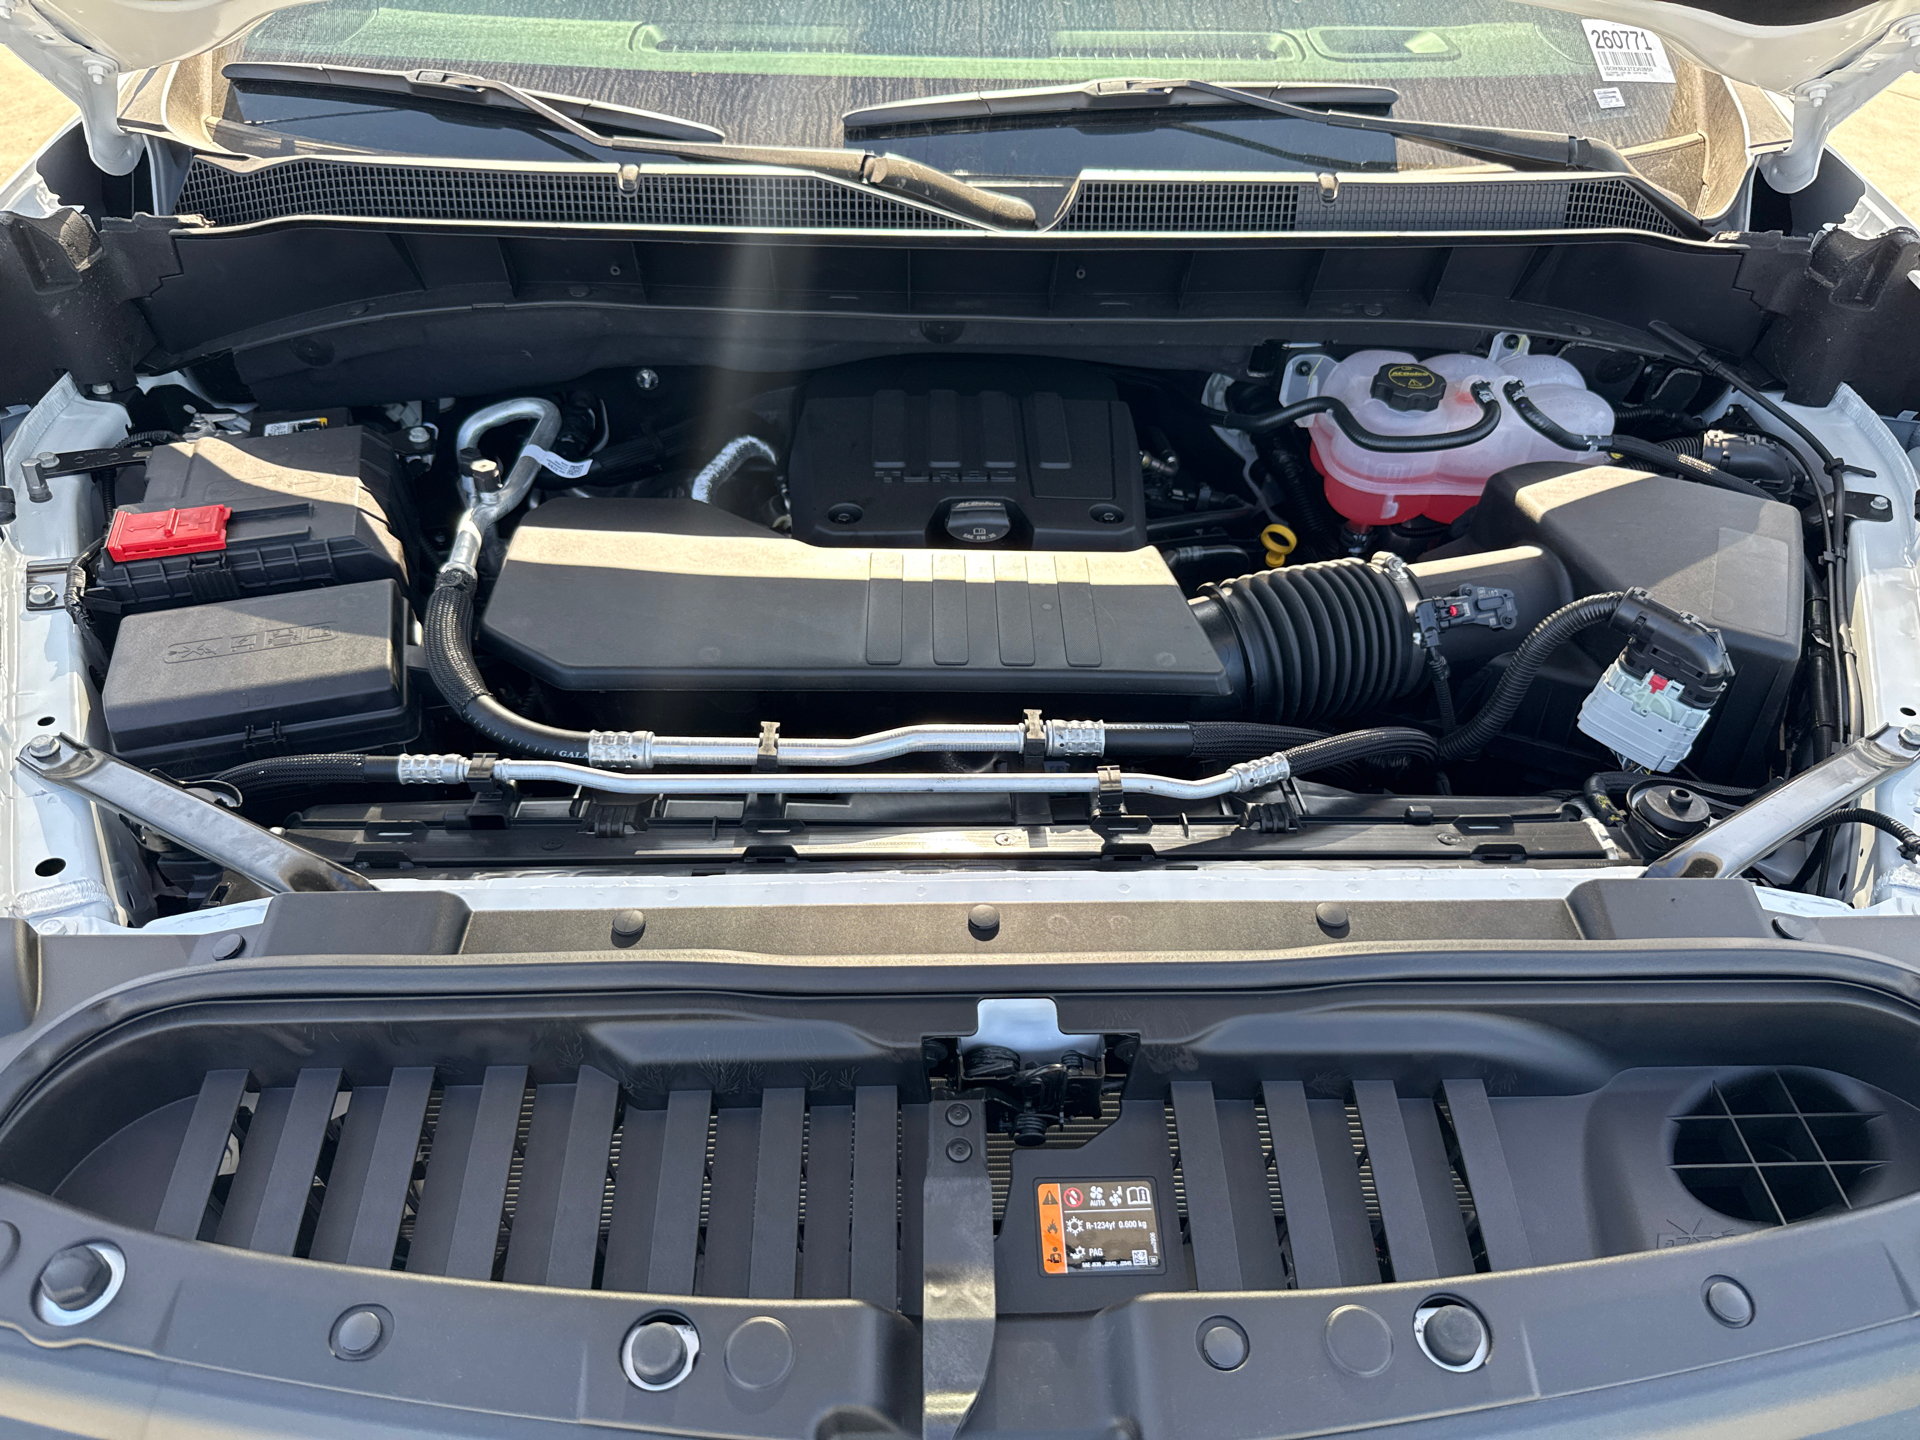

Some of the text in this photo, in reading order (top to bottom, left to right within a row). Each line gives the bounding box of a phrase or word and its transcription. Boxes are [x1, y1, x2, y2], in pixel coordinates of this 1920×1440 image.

[1591, 30, 1653, 50] 260771
[874, 469, 1017, 482] TURBO
[1089, 1199, 1106, 1207] AUTO
[1085, 1220, 1147, 1231] R-1234yf 0.600 kg
[1088, 1247, 1104, 1257] PAG
